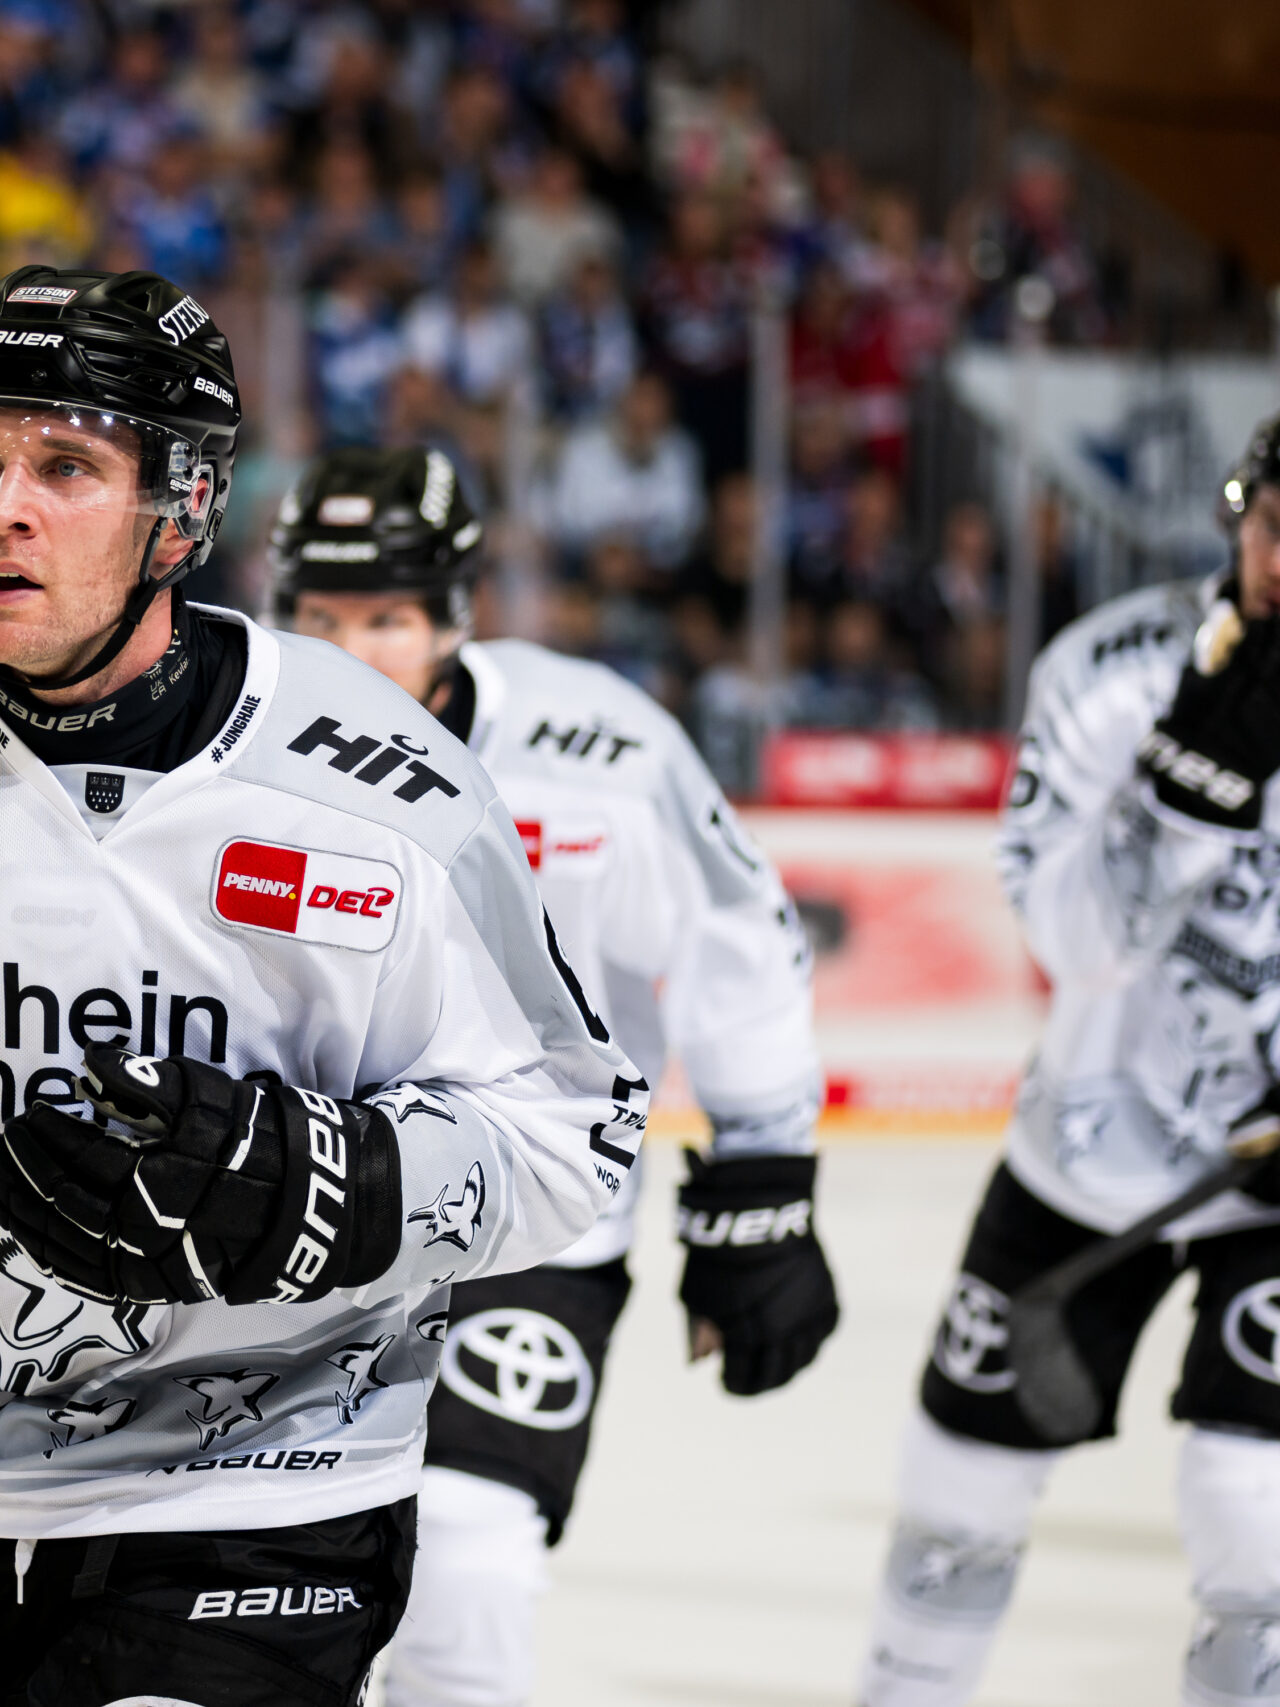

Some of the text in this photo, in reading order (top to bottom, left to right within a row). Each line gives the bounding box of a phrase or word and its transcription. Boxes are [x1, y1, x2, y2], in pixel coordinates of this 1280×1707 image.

[16, 287, 72, 298] STETSON
[158, 294, 210, 347] STETSO
[680, 1199, 812, 1246] UER
